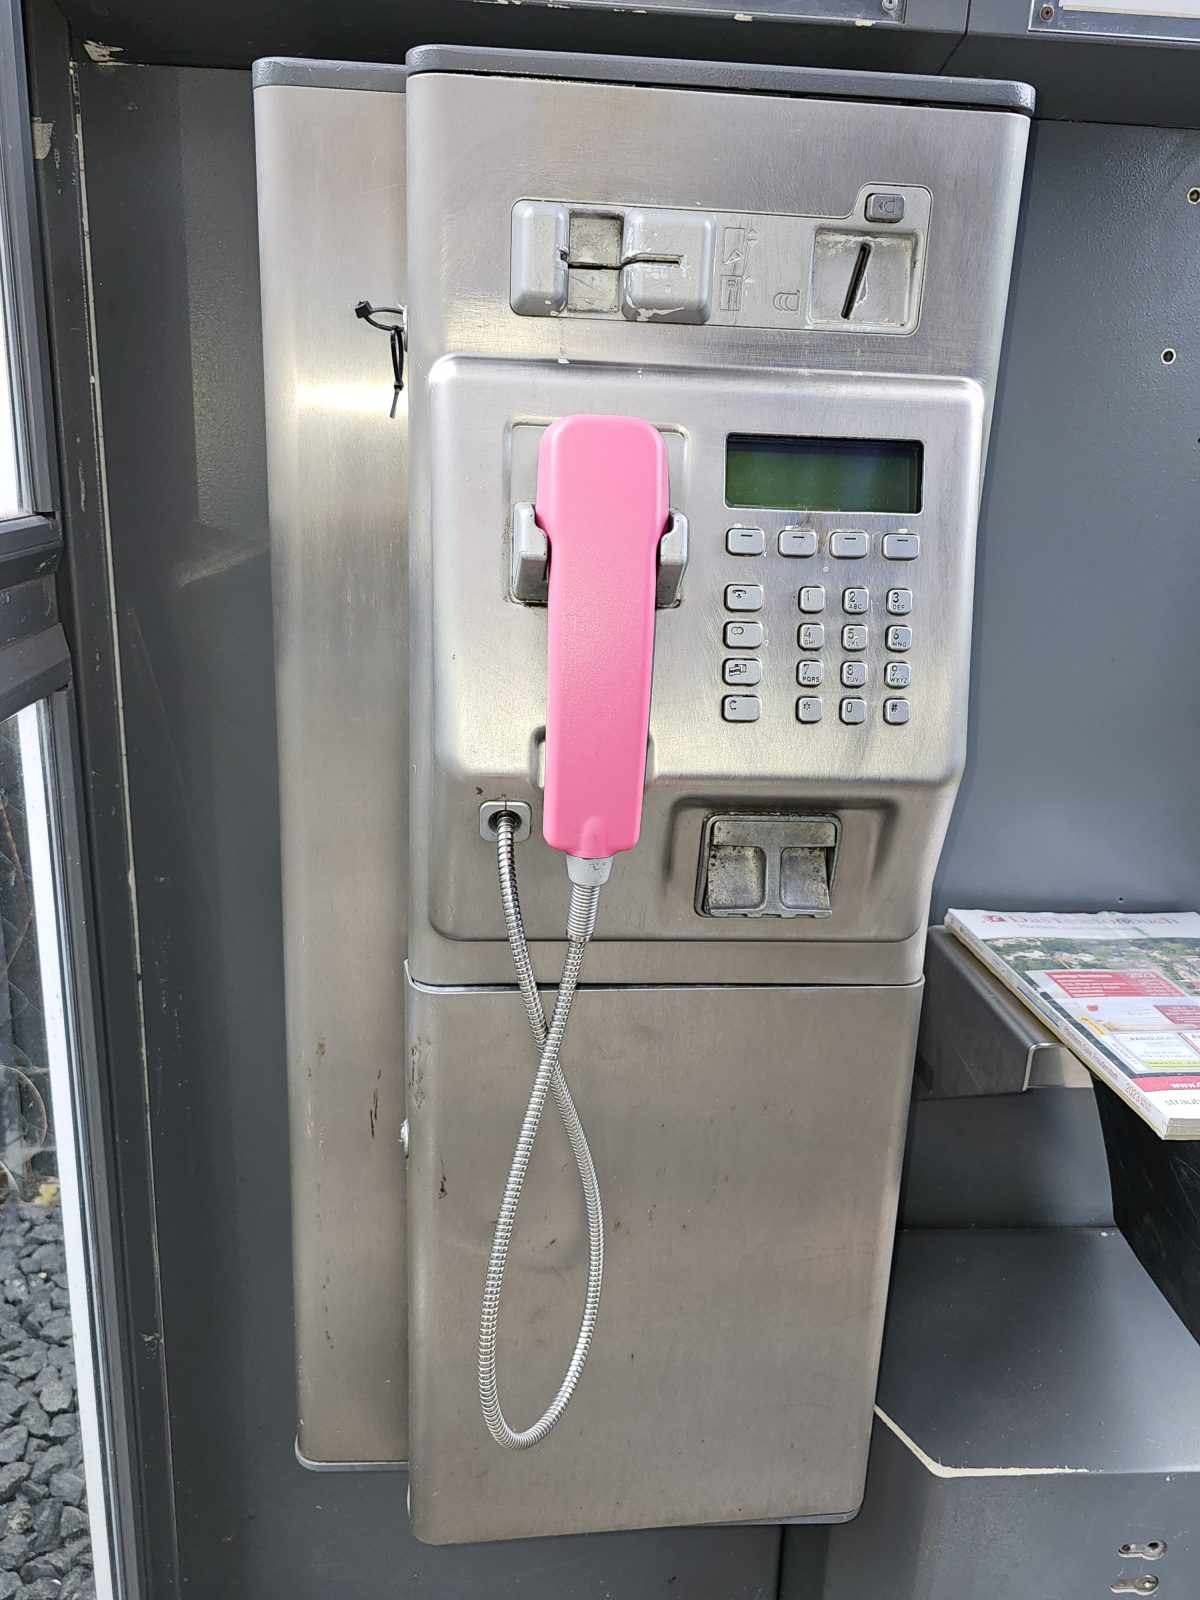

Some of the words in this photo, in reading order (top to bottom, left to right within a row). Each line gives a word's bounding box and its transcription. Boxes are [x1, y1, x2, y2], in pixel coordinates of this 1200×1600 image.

[848, 591, 856, 602] 2
[892, 592, 900, 603] 3
[804, 627, 812, 639] 4
[847, 628, 855, 640] 5
[893, 629, 900, 640] 6
[803, 663, 811, 676] 7
[846, 664, 854, 676] 8
[891, 665, 898, 677] 9
